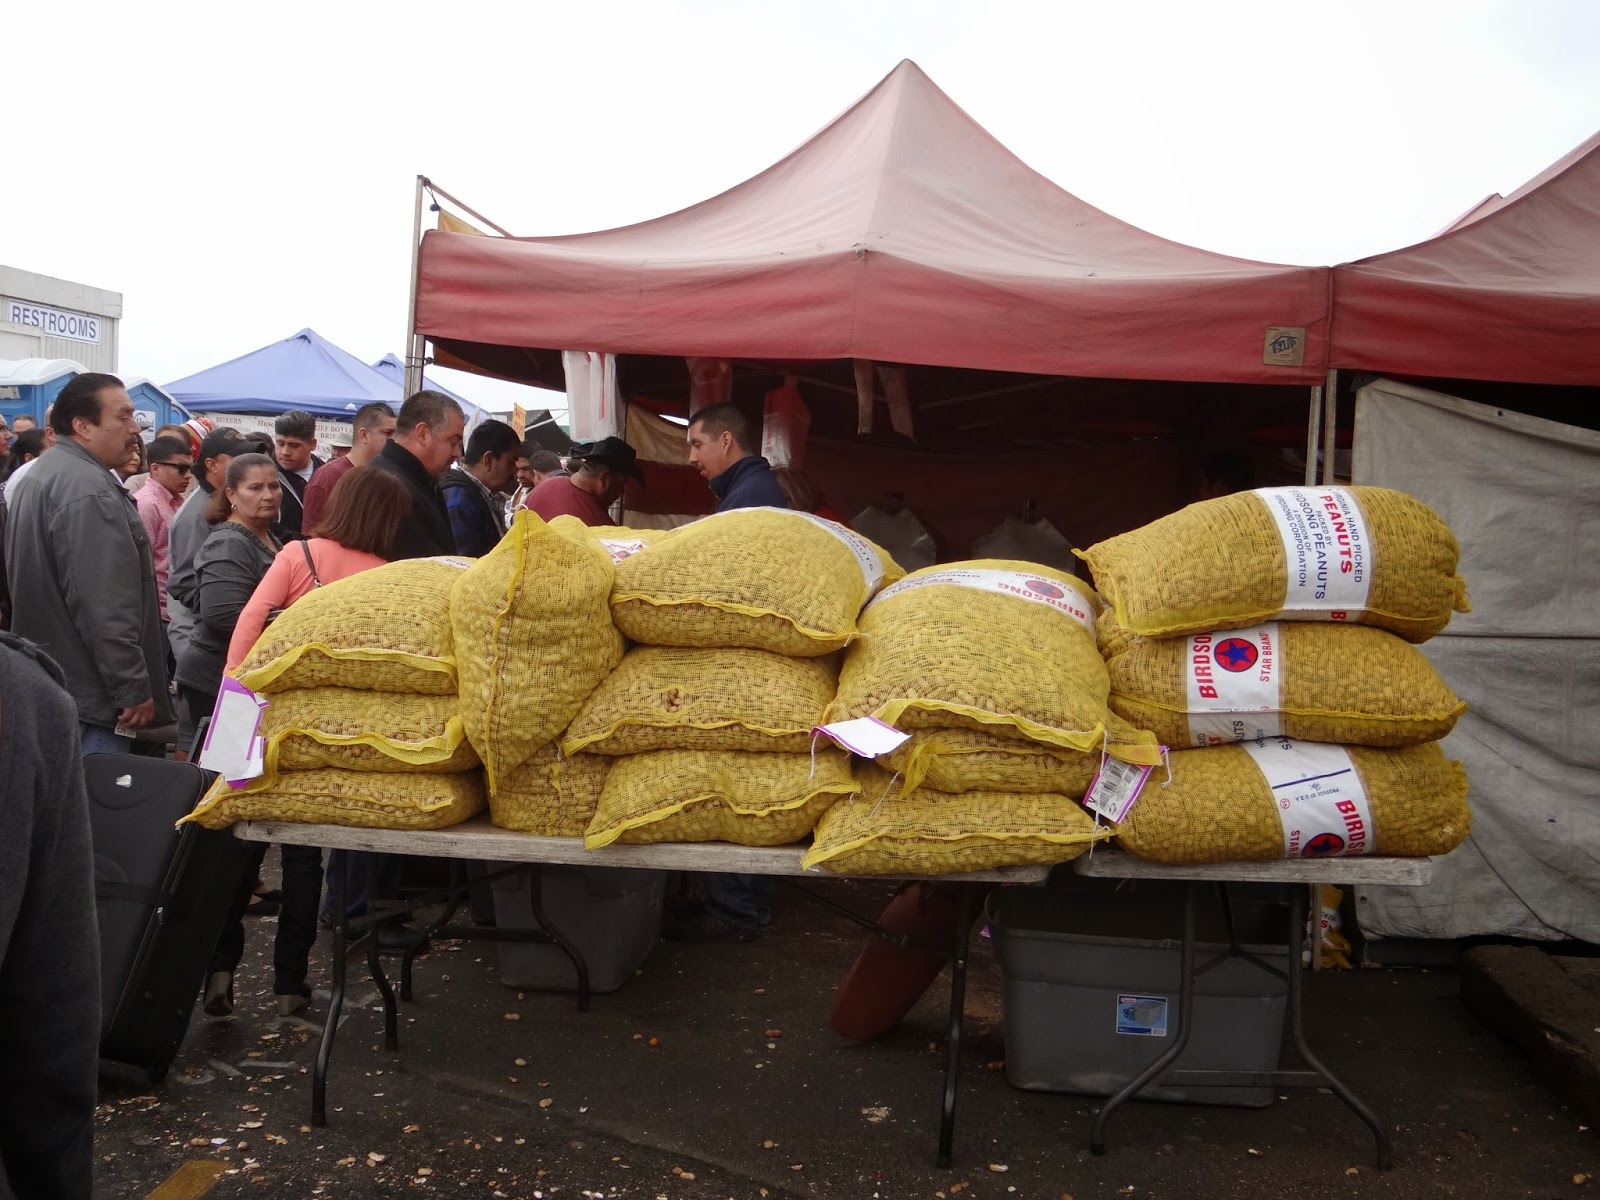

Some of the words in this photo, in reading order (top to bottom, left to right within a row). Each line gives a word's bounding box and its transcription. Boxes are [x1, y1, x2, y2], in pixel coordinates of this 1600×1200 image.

[12, 305, 97, 339] RESTROOMS
[215, 416, 242, 424] BOXERS
[1274, 494, 1294, 521] BIRDSONG
[1289, 522, 1307, 587] CORPORATION
[1288, 490, 1319, 529] BIRDSONG
[1312, 533, 1328, 600] PEANUTS
[1294, 513, 1310, 540] DIVISION
[1304, 541, 1312, 552] OF
[1315, 510, 1329, 535] PACKED
[1324, 536, 1333, 546] BY
[1320, 495, 1353, 574] PEANUTS
[1345, 517, 1360, 541] HAND
[1353, 544, 1363, 583] PICKED
[997, 582, 1085, 620] BIRDSONG
[1258, 632, 1272, 658] BRAND
[1192, 632, 1219, 699] BIRDSO
[1259, 659, 1272, 682] STAR
[1317, 787, 1340, 797] PRODUCE
[1288, 829, 1301, 853] STAR
